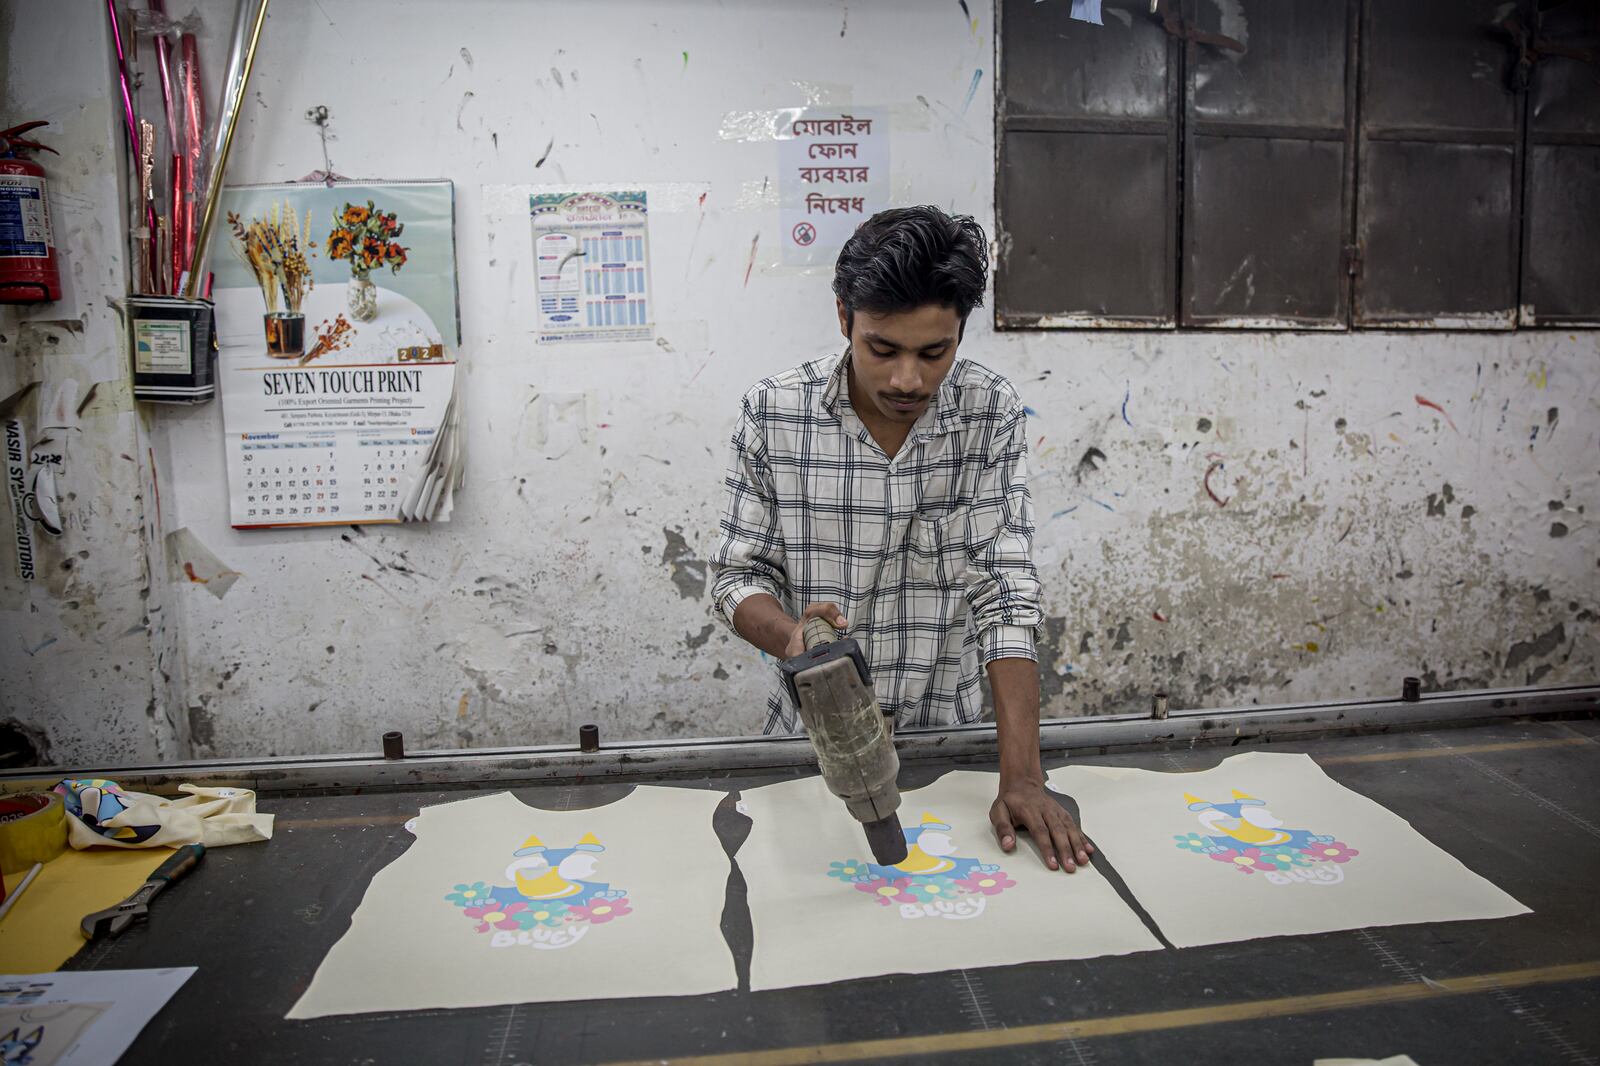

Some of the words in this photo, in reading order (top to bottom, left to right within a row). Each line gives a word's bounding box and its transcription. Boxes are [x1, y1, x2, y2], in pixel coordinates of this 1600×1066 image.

[793, 115, 872, 136] মোবাইল
[808, 142, 858, 160] ফোন
[798, 166, 869, 184] ব্যবহার
[805, 193, 865, 215] নিষেধ
[263, 371, 316, 396] SEVEN
[319, 371, 373, 394] TOUCH
[378, 370, 422, 393] PRINT
[298, 398, 316, 407] Export
[5, 420, 22, 461] NASIR
[241, 432, 280, 440] November
[1264, 863, 1344, 885] BLUEY
[899, 896, 986, 920] BLUEY
[489, 925, 589, 950] BLUEY
